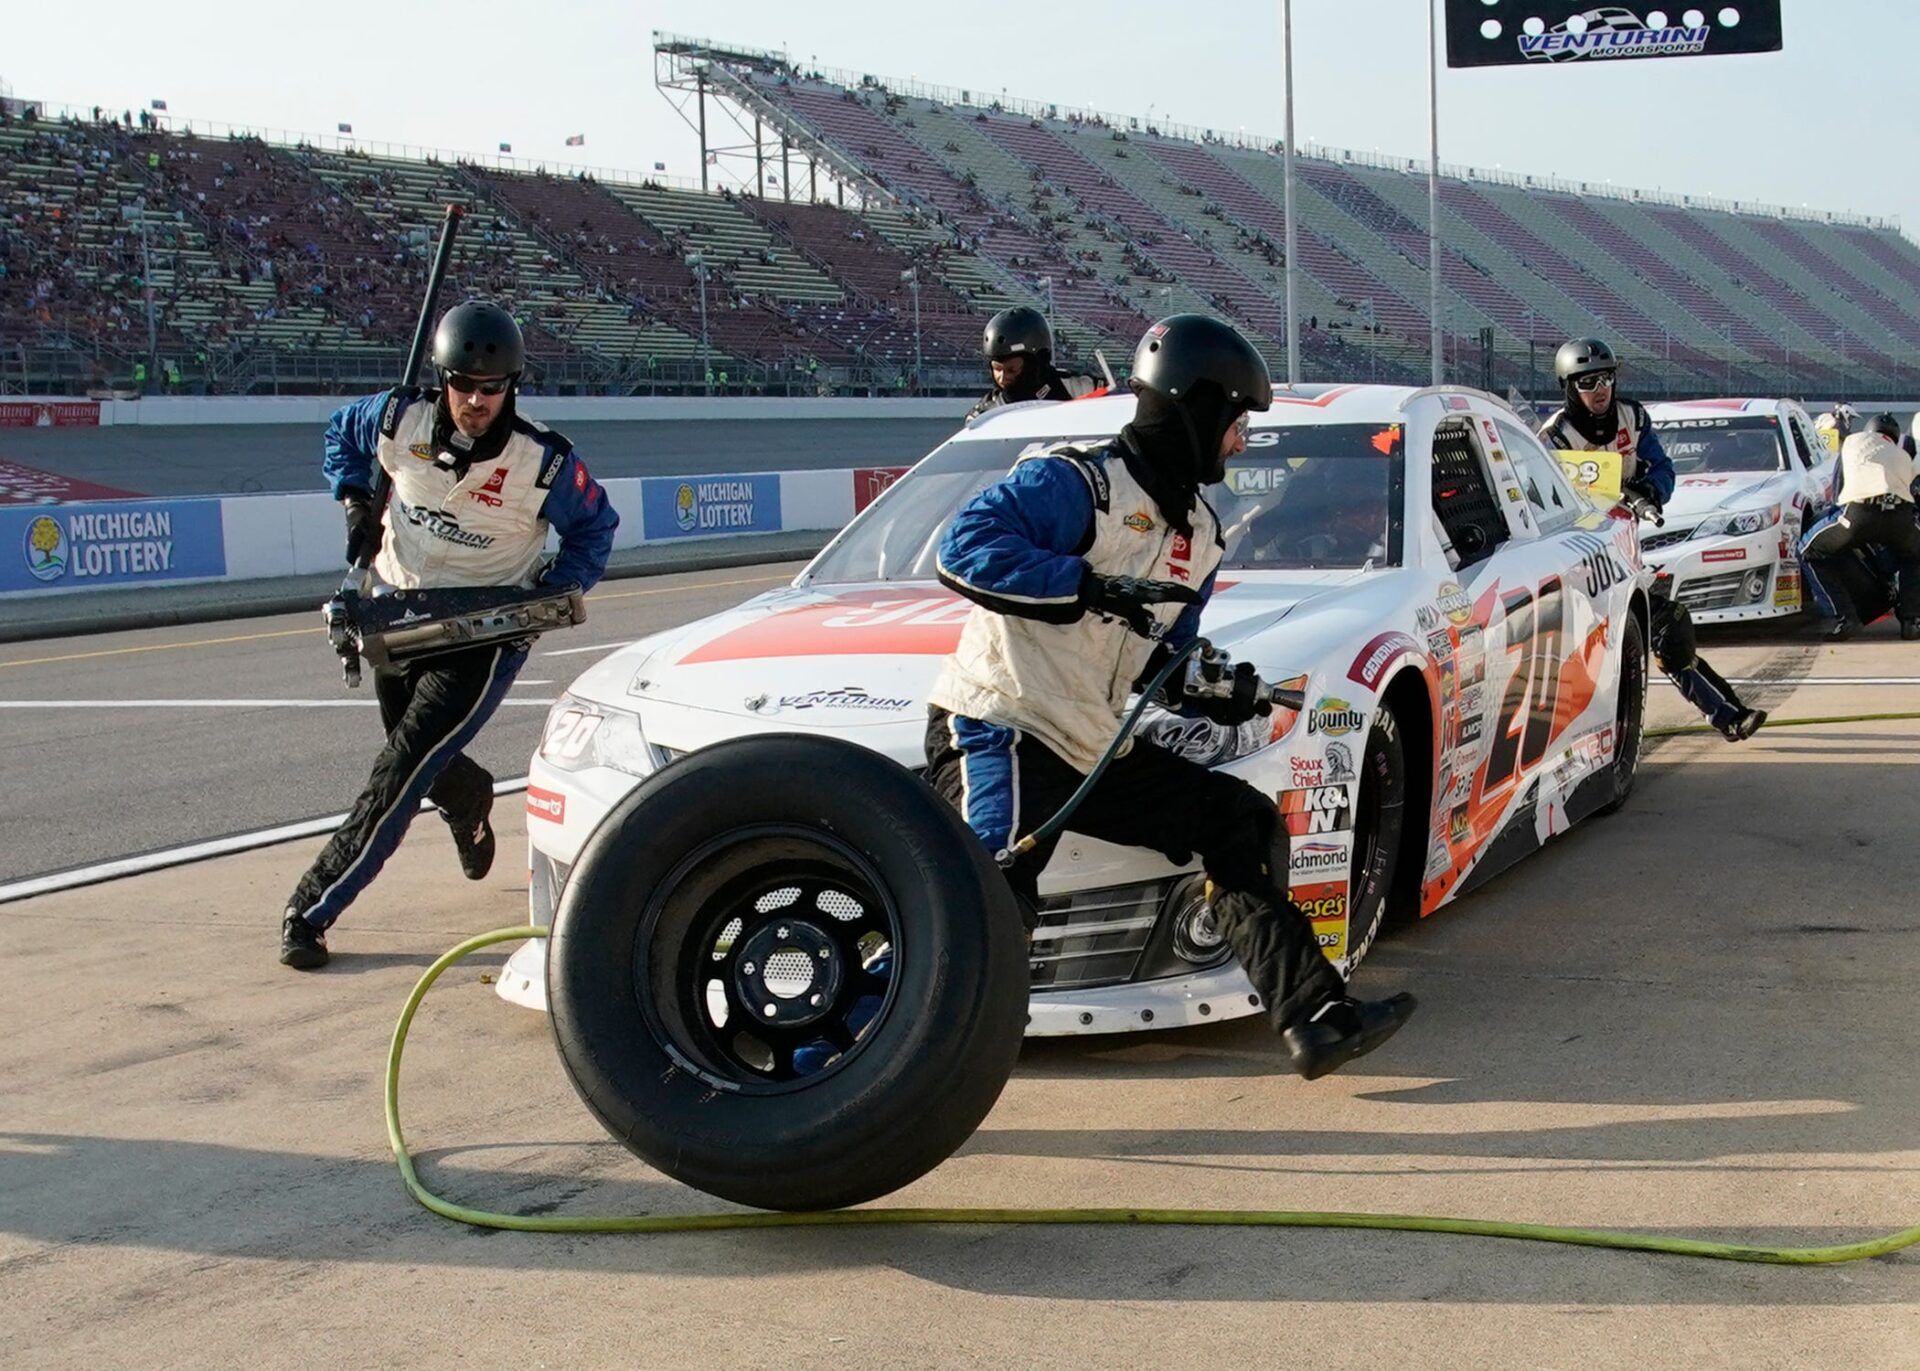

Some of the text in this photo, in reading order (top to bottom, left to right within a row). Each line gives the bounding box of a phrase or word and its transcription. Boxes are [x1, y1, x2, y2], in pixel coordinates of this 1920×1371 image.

[1518, 26, 1710, 51] VENTURINI
[1590, 42, 1704, 58] MOTORSPORTS
[698, 482, 753, 502] MICHIGAN
[70, 510, 171, 542] MICHIGAN
[699, 503, 754, 529] LOTTERY
[72, 540, 174, 577] LOTTERY
[779, 695, 913, 707] VENTURINI
[1307, 708, 1364, 735] Bounty
[1290, 755, 1324, 772] Sioux
[1292, 771, 1324, 787] Chief
[1288, 889, 1347, 918] ese's
